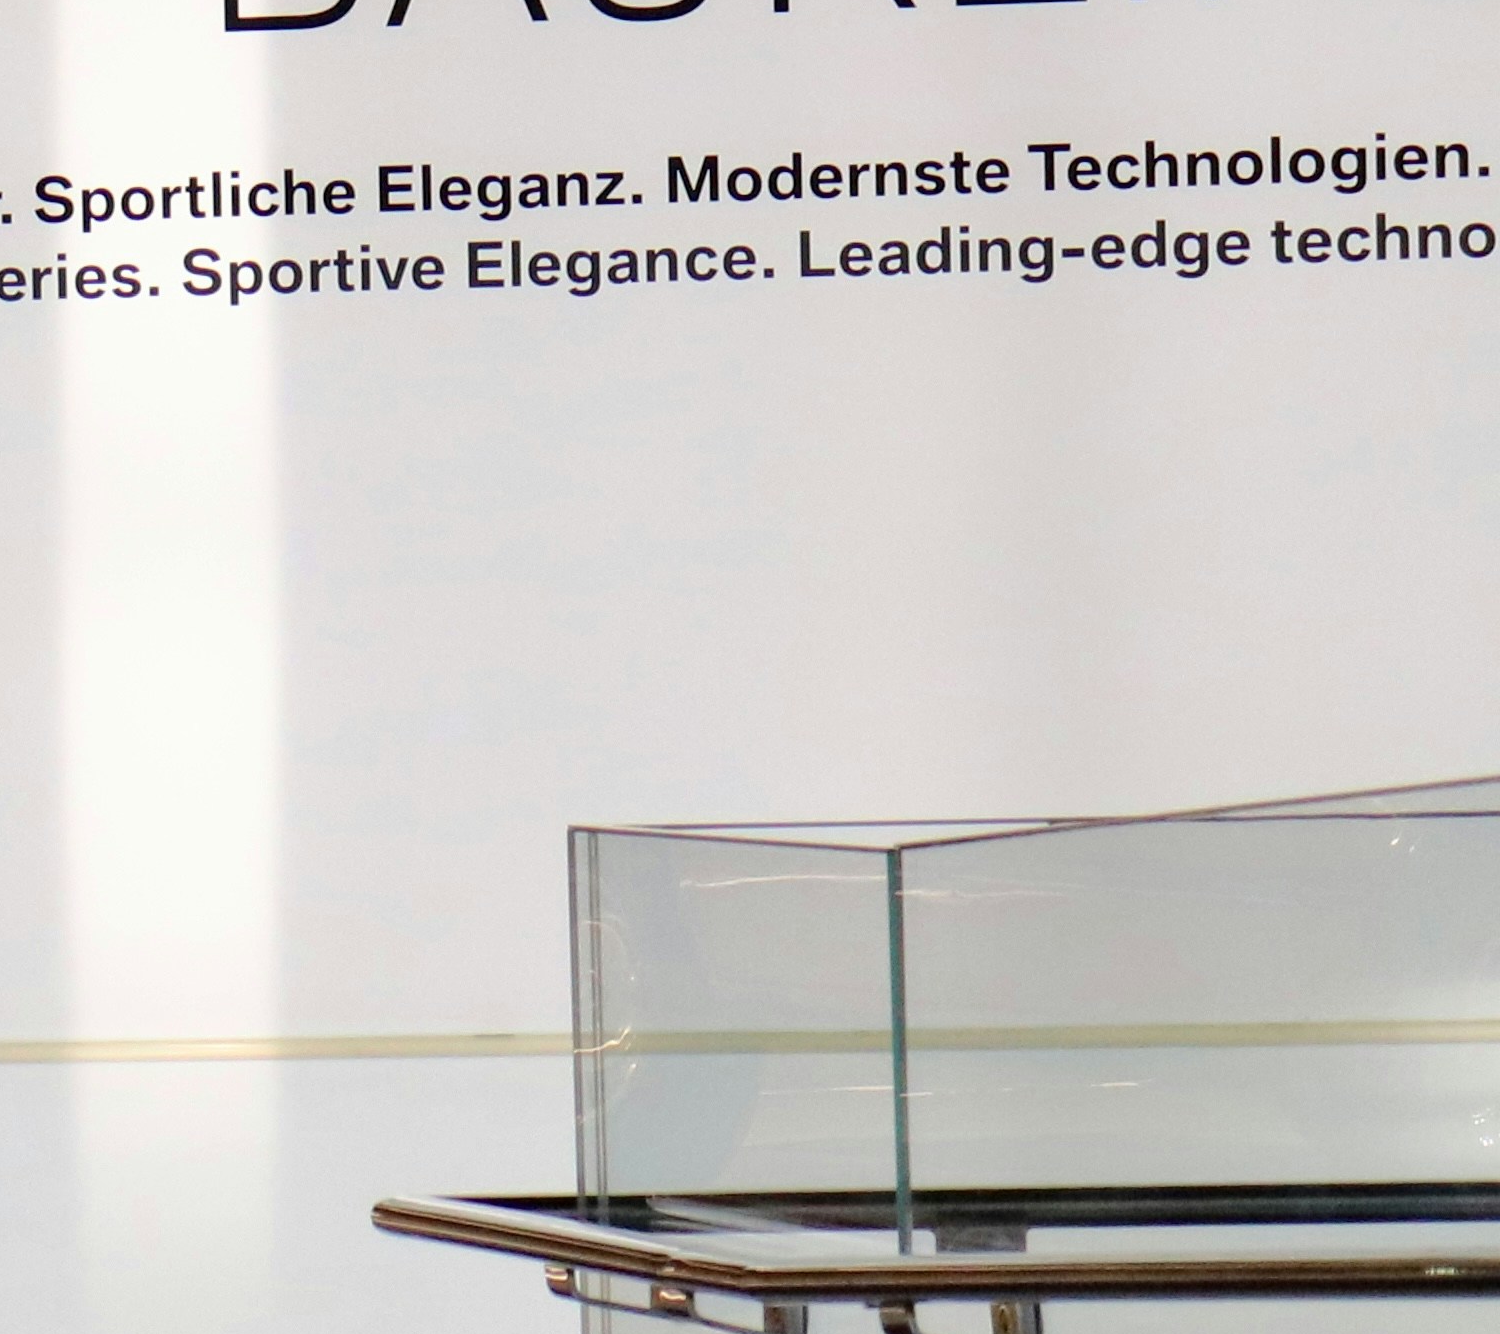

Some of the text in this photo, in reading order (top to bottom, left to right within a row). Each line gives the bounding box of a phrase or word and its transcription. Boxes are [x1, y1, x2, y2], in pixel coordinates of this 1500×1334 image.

[34, 168, 356, 233] Sportliche
[378, 164, 643, 222] Eleganz.
[667, 151, 1010, 203] Modernste
[1027, 132, 1490, 195] Technologien.
[183, 244, 445, 306] Sportive
[467, 240, 775, 297] Elegance.
[799, 219, 1251, 284] Leading-edge
[1270, 212, 1496, 264] techno
